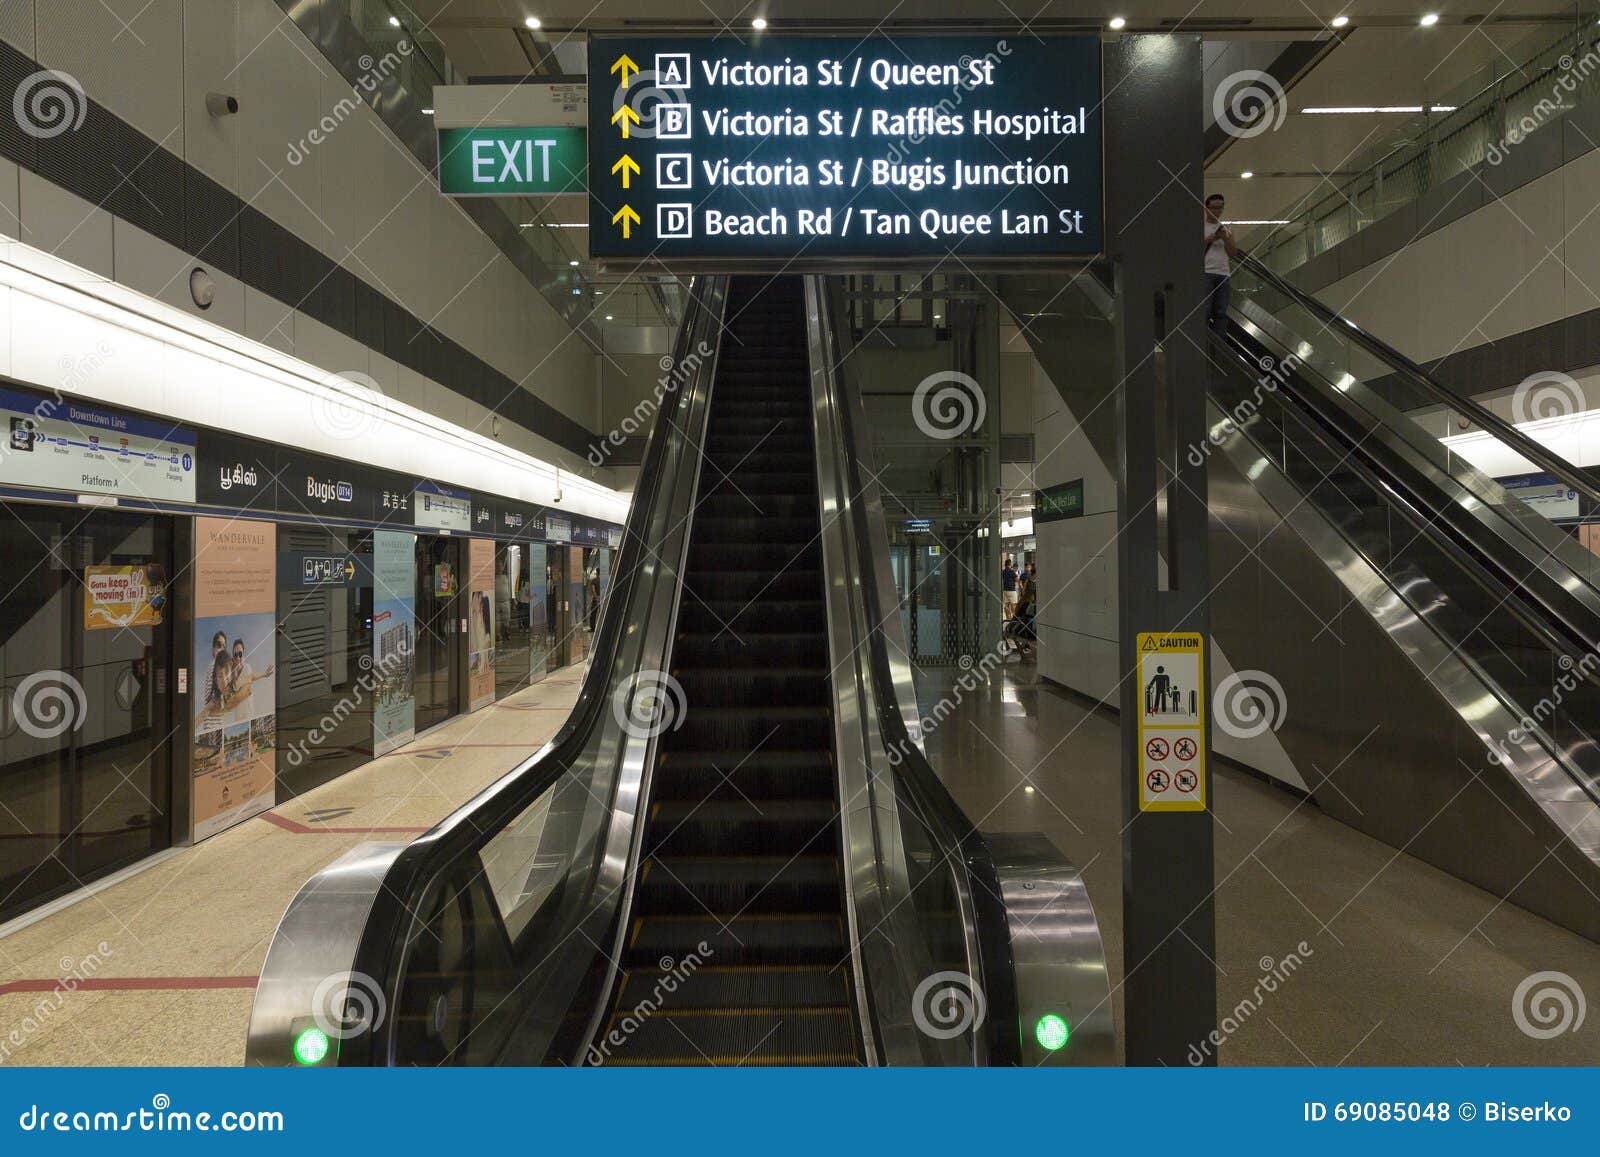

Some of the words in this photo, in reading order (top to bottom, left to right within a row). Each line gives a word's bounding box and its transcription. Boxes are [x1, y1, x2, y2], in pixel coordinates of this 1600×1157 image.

[702, 58, 808, 86] Victoria
[817, 59, 843, 86] St
[851, 57, 862, 87] /
[870, 59, 959, 90] Queen
[969, 59, 994, 86] St
[702, 108, 808, 136] Victoria
[818, 110, 843, 136] St
[851, 107, 862, 137] /
[872, 107, 964, 135] Raffles
[973, 107, 1085, 140] Hospital
[472, 140, 556, 182] EXIT
[703, 157, 809, 186] Victoria
[818, 160, 843, 186] St
[852, 157, 863, 187] /
[872, 157, 946, 191] Bugis
[952, 157, 1069, 190] Junction
[705, 207, 787, 235] Beach
[799, 207, 832, 235] Rd
[842, 207, 853, 236] /
[860, 209, 910, 234] Tan
[920, 208, 992, 239] Quee
[1002, 209, 1048, 234] Lan
[1059, 209, 1084, 234] St
[70, 408, 110, 427] Downtown
[111, 416, 127, 429] Line
[82, 474, 112, 487] Platform
[113, 479, 119, 488] A
[220, 463, 257, 490] பூகிஸ்
[307, 476, 336, 503] Bugis
[95, 589, 124, 601] moving
[108, 577, 129, 589] keep
[1159, 638, 1199, 649] CAUTION
